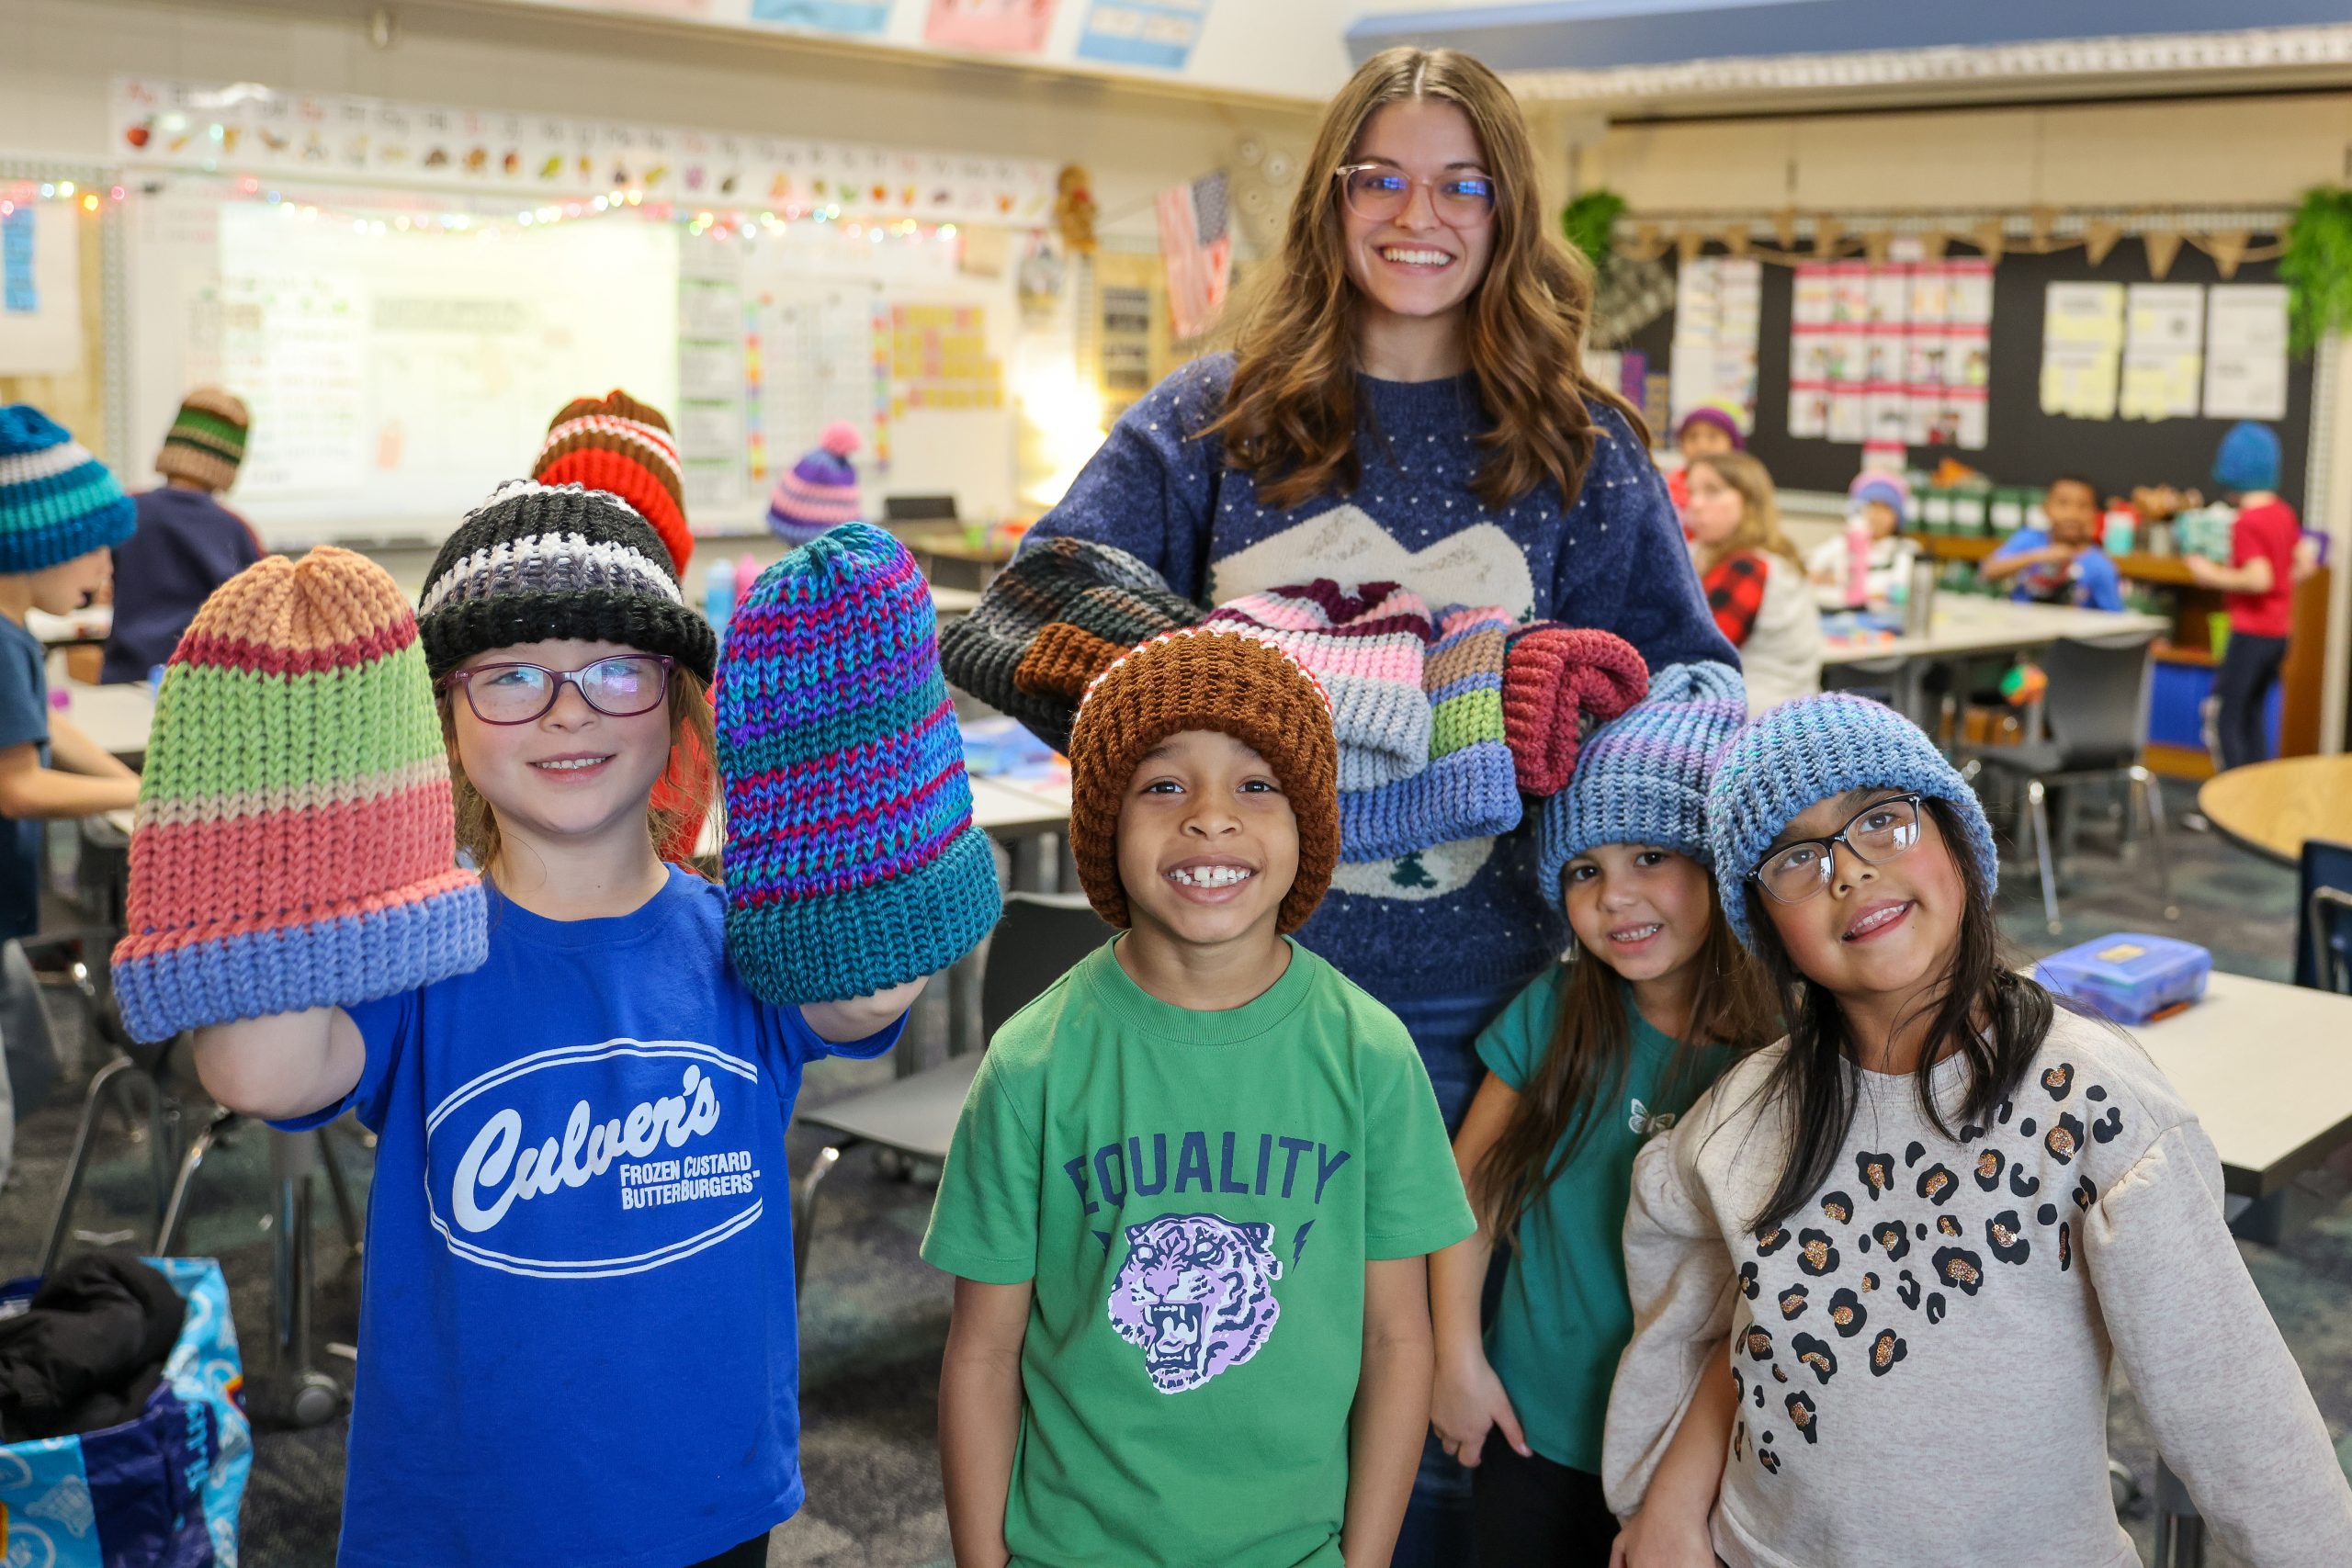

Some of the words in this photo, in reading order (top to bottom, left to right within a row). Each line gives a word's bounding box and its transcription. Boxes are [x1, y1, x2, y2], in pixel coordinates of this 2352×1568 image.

[452, 1065, 720, 1232] Culver's
[620, 1160, 681, 1187] FROZEN
[684, 1150, 752, 1179] CUSTARD
[1063, 1131, 1351, 1216] EQUALITY
